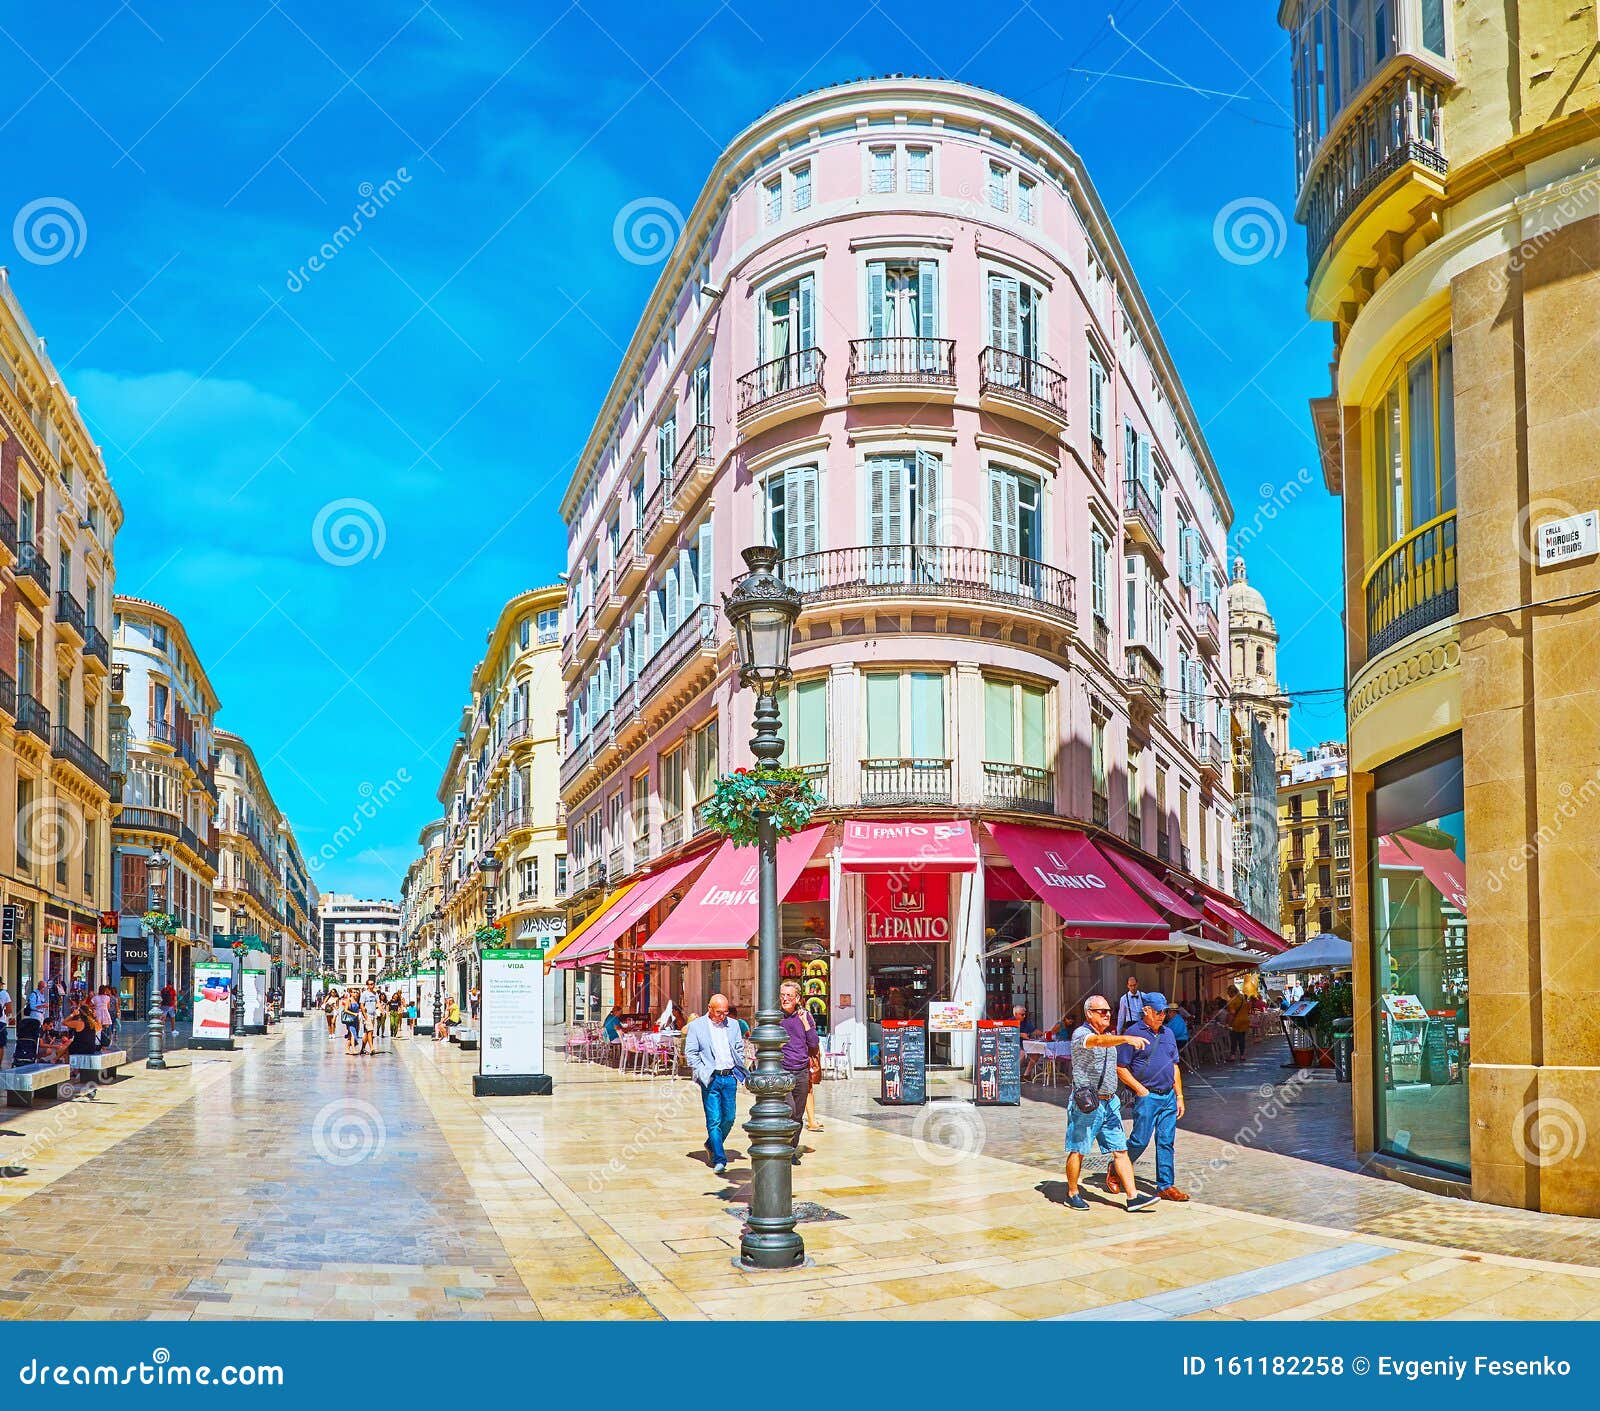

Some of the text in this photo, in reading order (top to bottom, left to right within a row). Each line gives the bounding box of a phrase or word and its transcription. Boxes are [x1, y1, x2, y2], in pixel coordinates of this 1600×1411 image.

[1545, 526, 1561, 536] CALLE
[1546, 541, 1582, 559] DE LARIOS
[1033, 866, 1107, 889] LEPANTO
[868, 912, 949, 938] LEPANTO
[125, 950, 148, 958] TOUS
